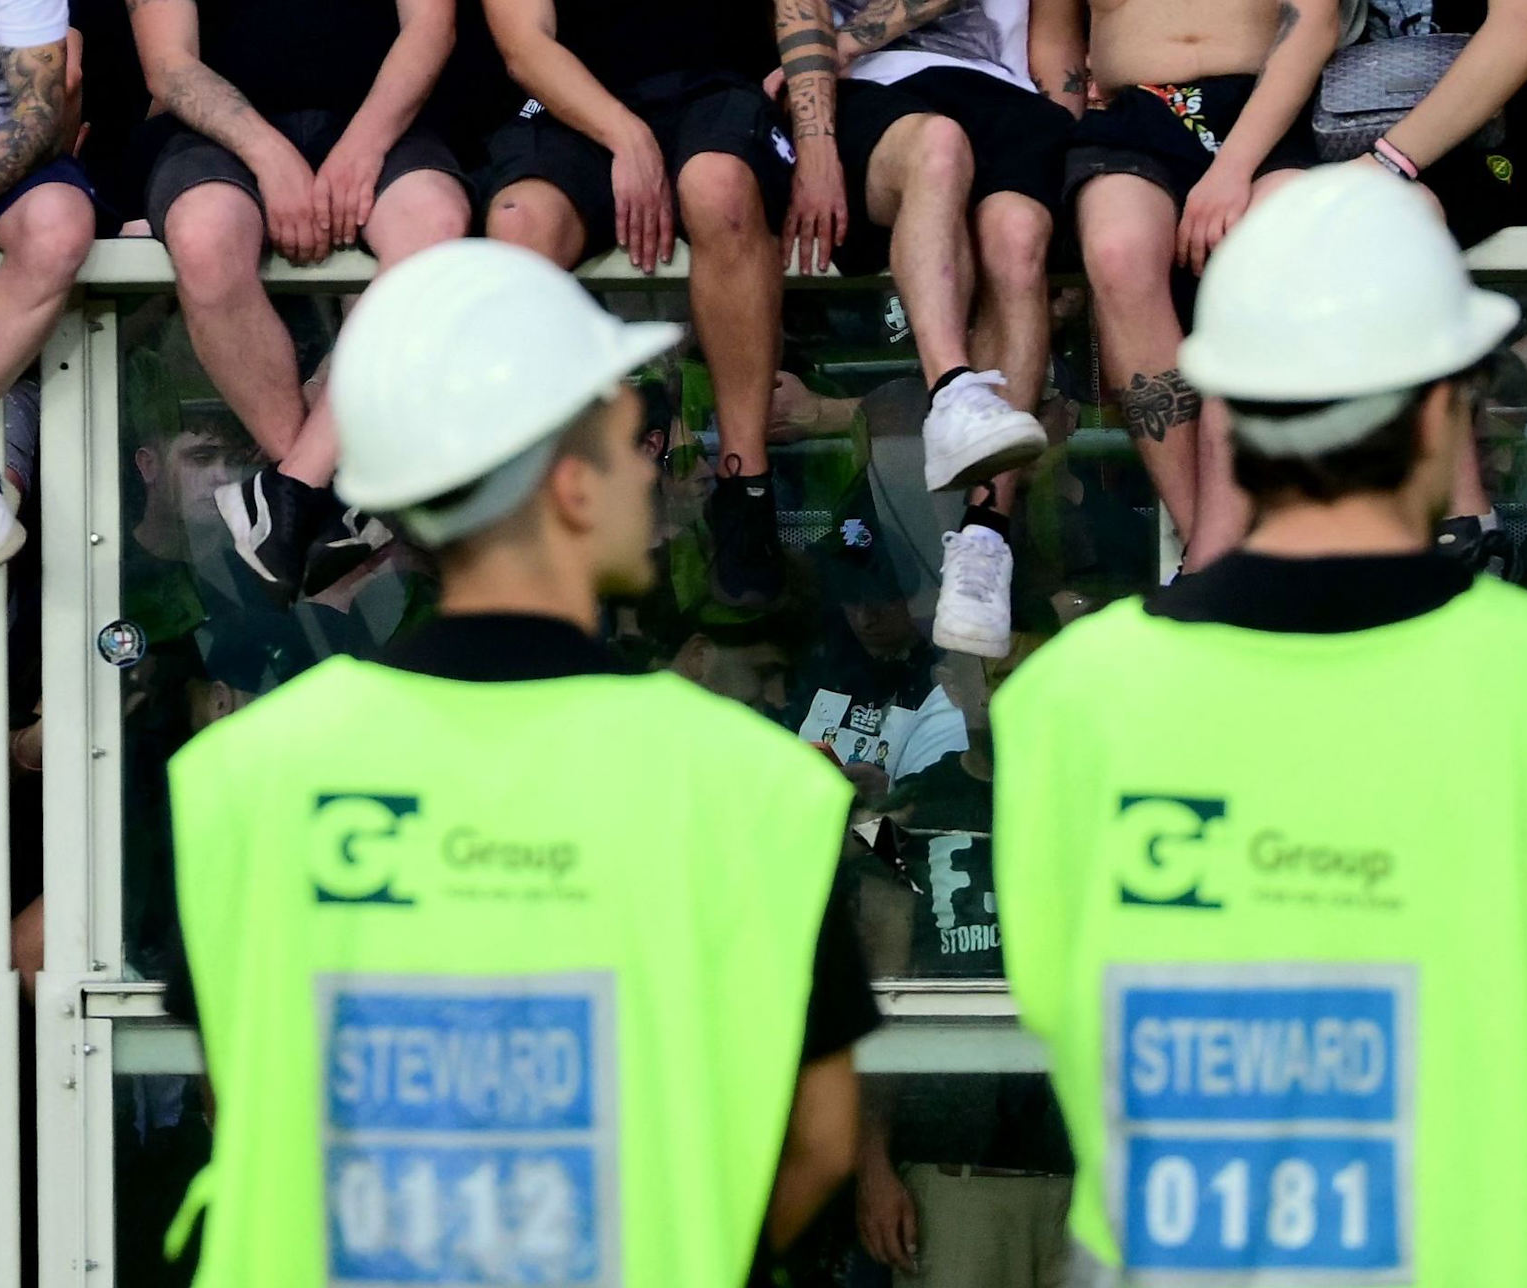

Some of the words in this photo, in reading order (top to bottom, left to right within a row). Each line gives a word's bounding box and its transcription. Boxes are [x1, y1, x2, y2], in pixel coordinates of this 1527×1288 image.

[442, 825, 582, 877] Group
[1249, 829, 1397, 888] Group
[939, 924, 1002, 955] STORIC
[333, 1022, 584, 1110] STEWARD
[1131, 1015, 1388, 1097] STEWARD
[338, 1162, 578, 1260] 0112
[1142, 1154, 1372, 1253] 0181
